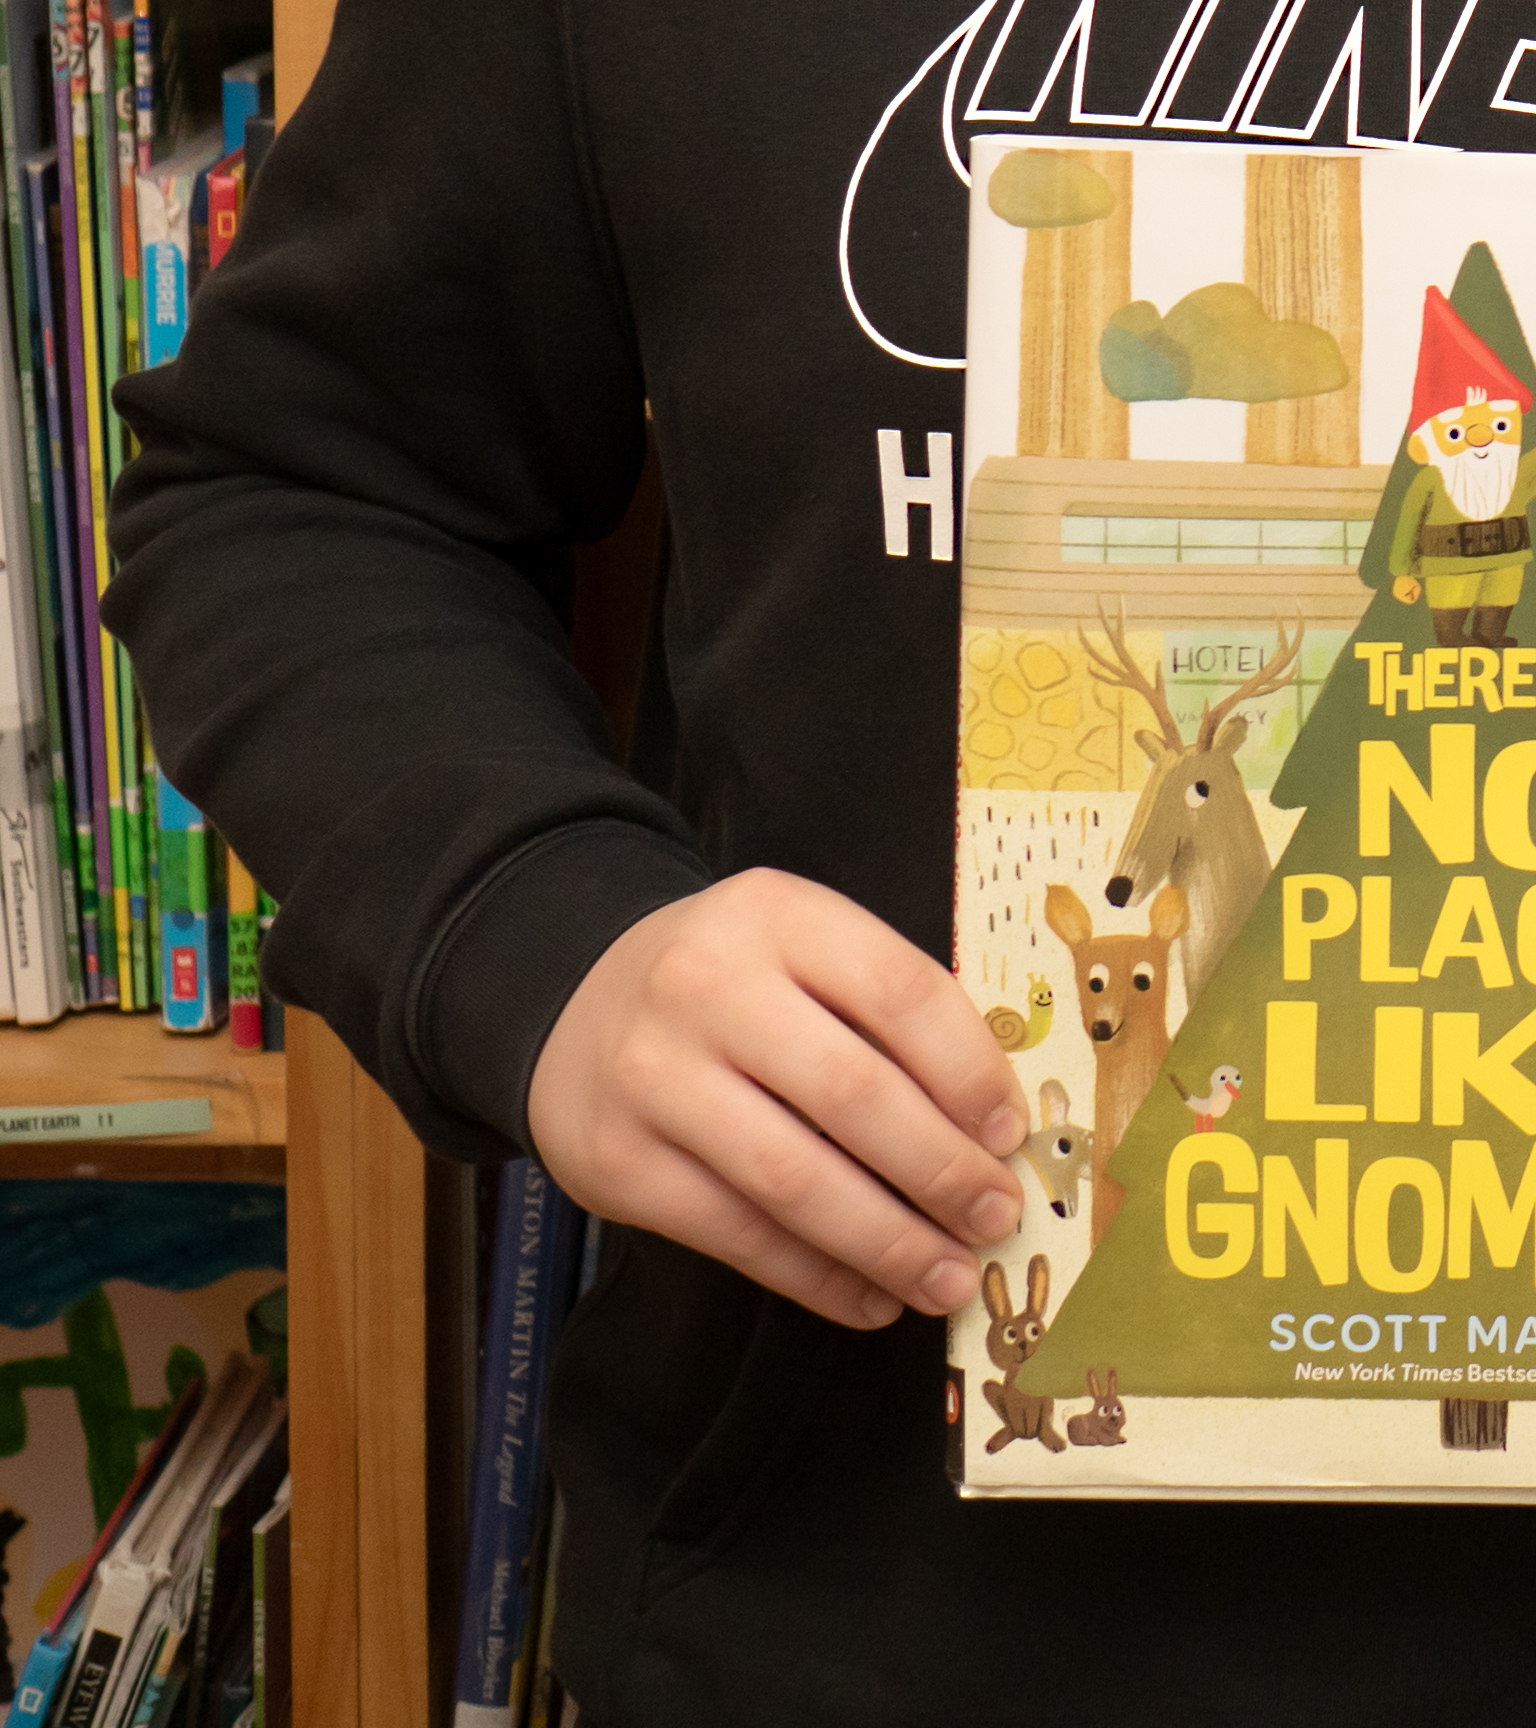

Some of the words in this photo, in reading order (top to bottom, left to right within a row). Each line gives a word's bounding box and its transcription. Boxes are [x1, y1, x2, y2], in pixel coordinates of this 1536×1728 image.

[1172, 644, 1265, 674] HOTEL
[508, 1265, 539, 1381] MARTIN
[1269, 1313, 1447, 1354] SCOTT
[1295, 1362, 1344, 1382] New
[1349, 1362, 1395, 1382] York
[1401, 1362, 1463, 1383] Times
